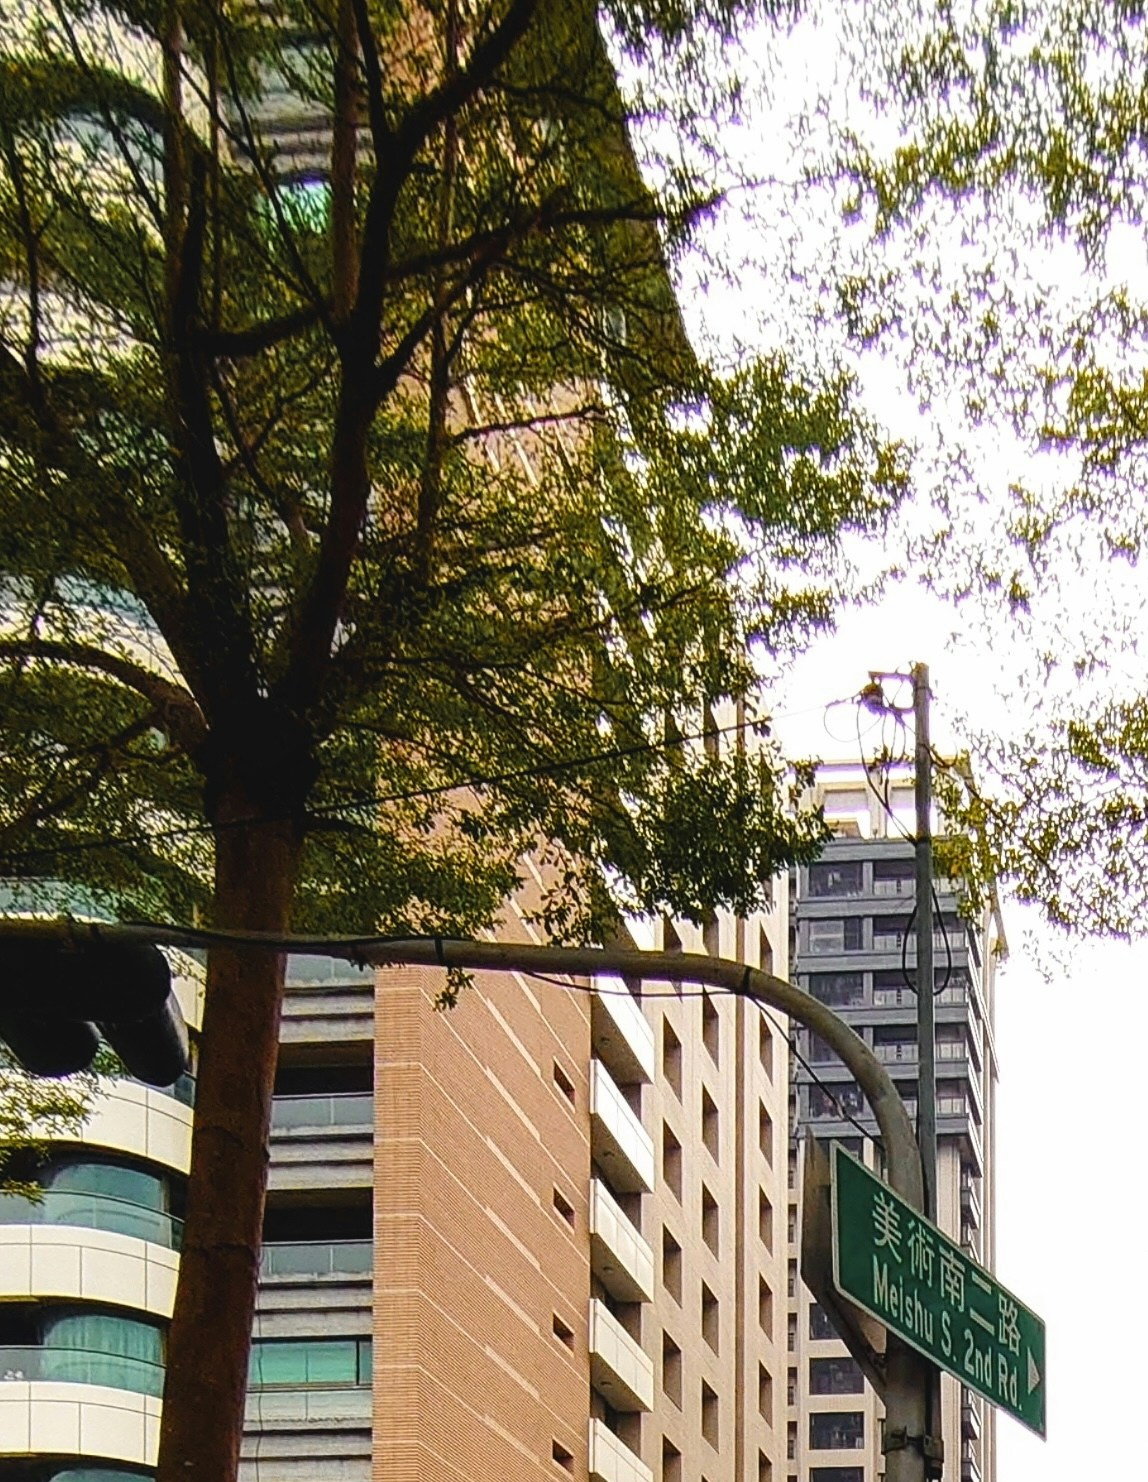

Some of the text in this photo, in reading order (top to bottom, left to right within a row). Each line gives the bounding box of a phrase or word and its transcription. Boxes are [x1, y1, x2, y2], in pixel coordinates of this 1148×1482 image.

[872, 1191, 1021, 1356] 美術南二路
[872, 1257, 1023, 1412] Meishu S. 2nd Rd.
